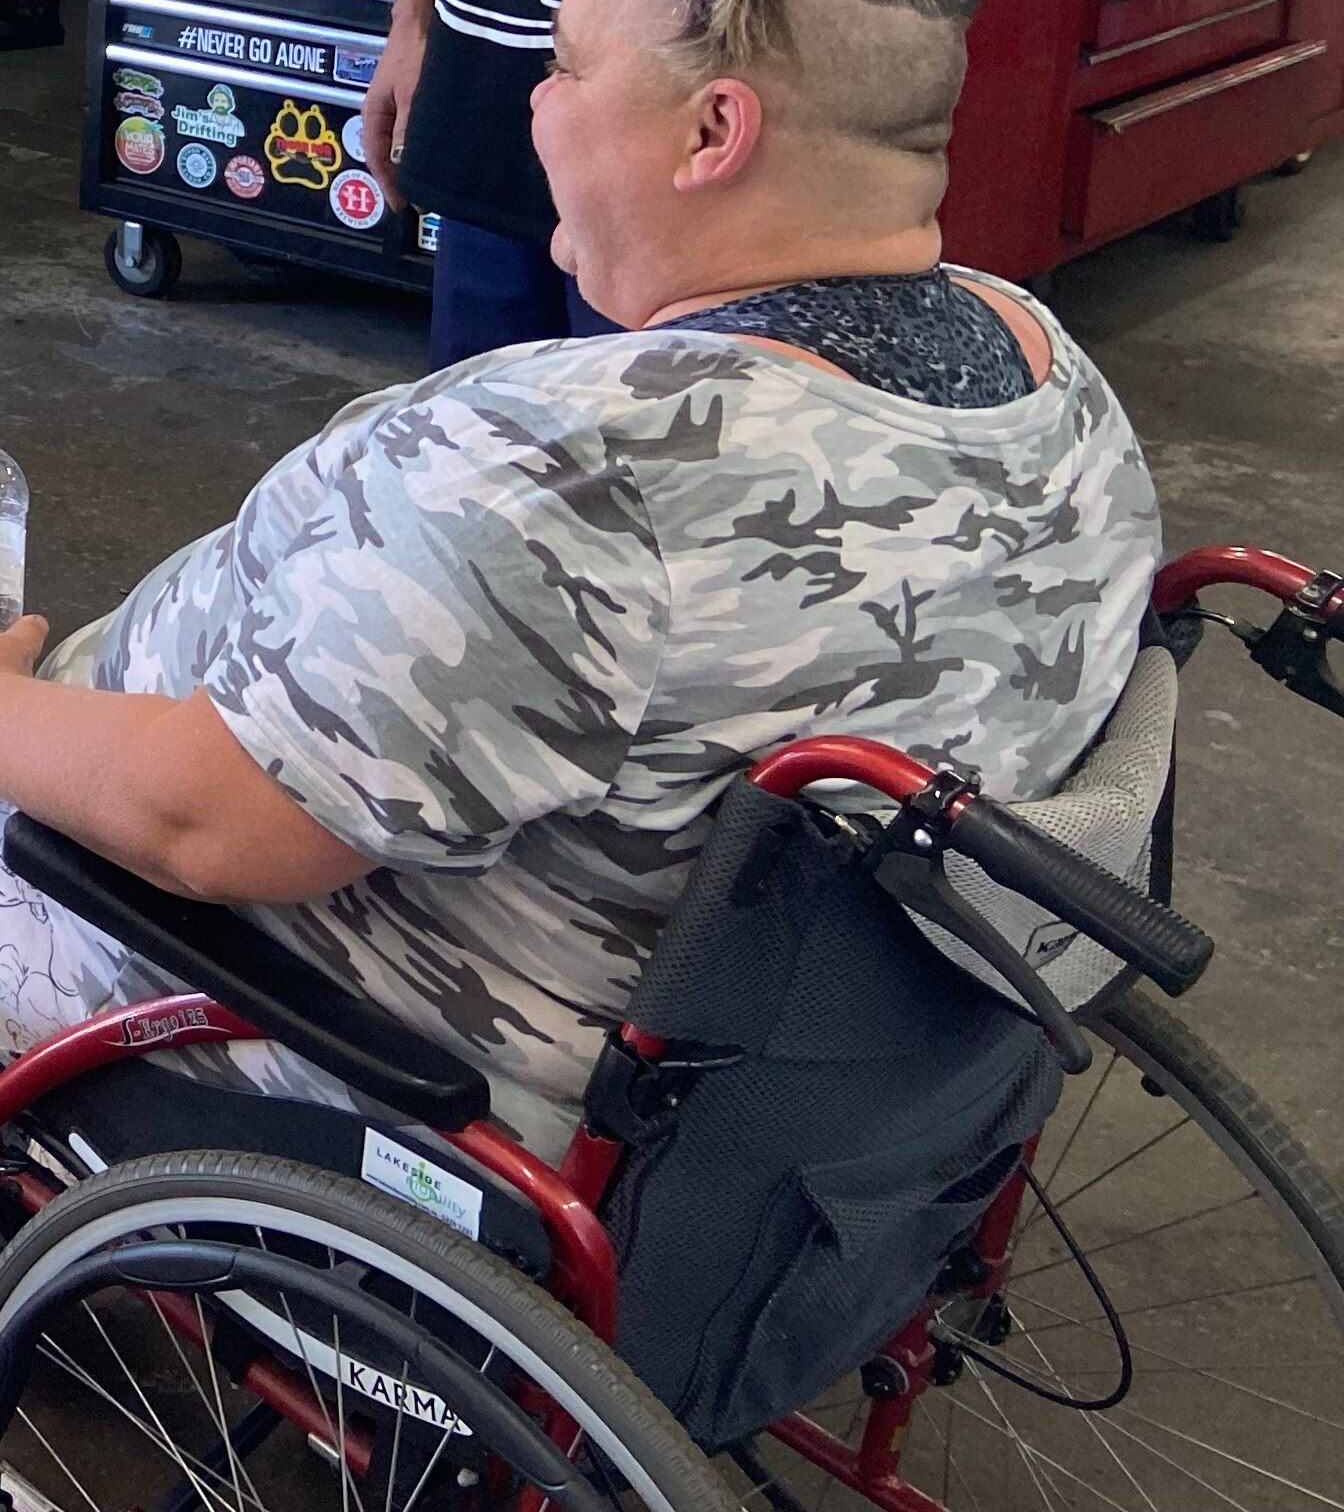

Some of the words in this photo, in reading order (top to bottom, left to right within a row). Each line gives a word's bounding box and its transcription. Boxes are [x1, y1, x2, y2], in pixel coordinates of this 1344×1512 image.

[178, 25, 246, 60] #NEVER
[248, 36, 272, 64] GO
[275, 41, 328, 74] ALONE
[173, 106, 210, 124] Jim's
[179, 120, 236, 146] Drifting
[376, 1147, 443, 1191] LAKESIDE
[348, 1361, 462, 1432] KARMA
